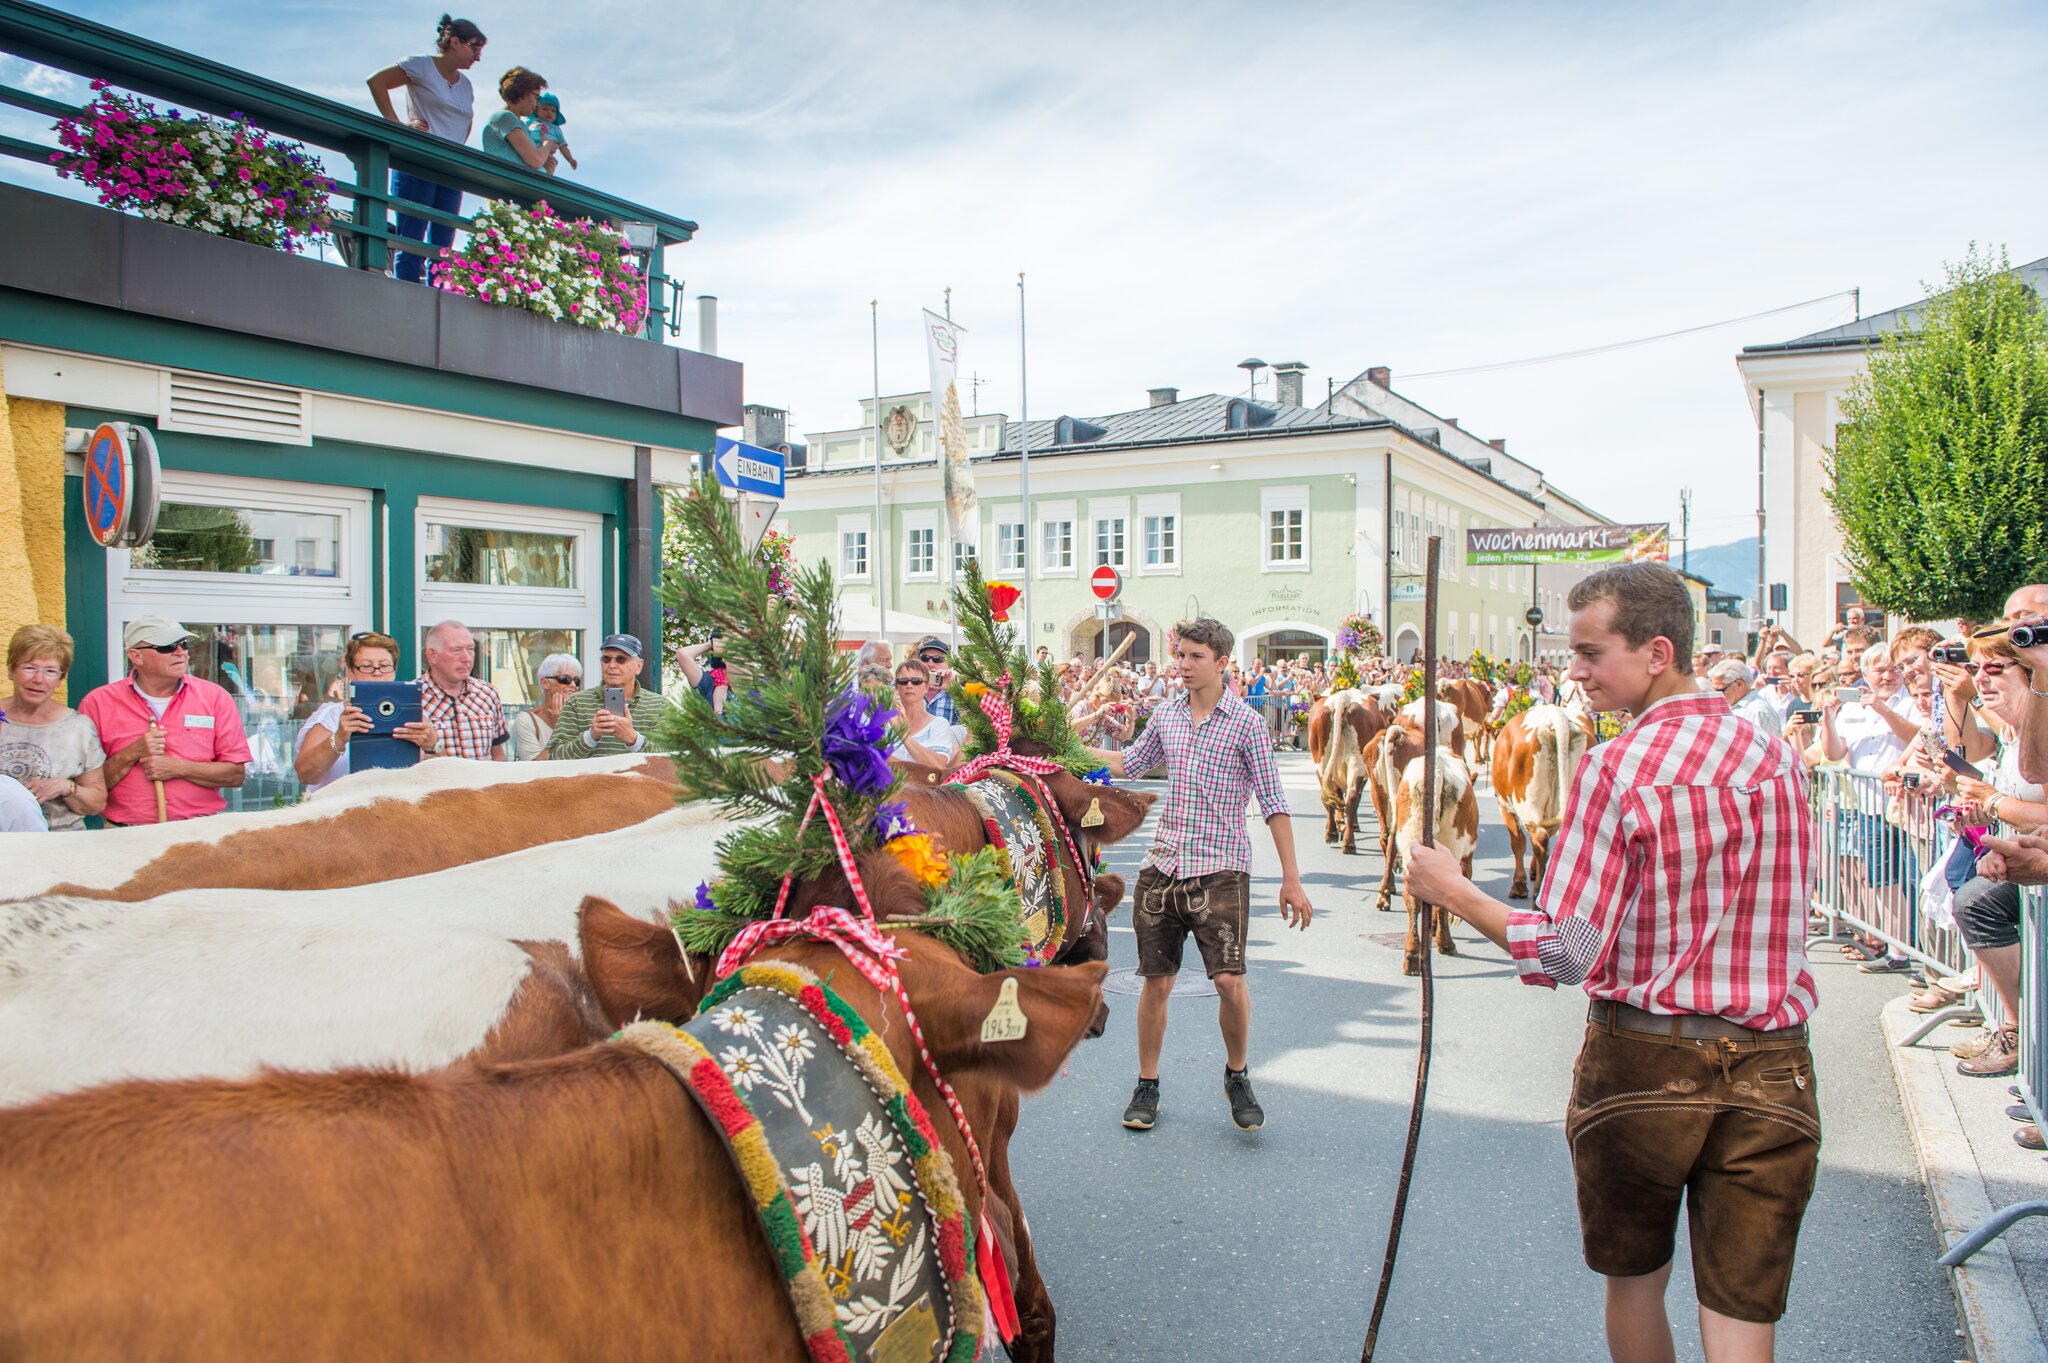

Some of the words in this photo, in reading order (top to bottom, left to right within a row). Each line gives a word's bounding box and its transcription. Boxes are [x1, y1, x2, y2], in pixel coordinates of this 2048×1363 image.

[737, 458, 774, 481] EINBAHN
[1476, 553, 1501, 564] jeden
[1503, 552, 1534, 563] Freitag
[1251, 604, 1320, 616] INFORMATION
[984, 1017, 1011, 1040] 1943
